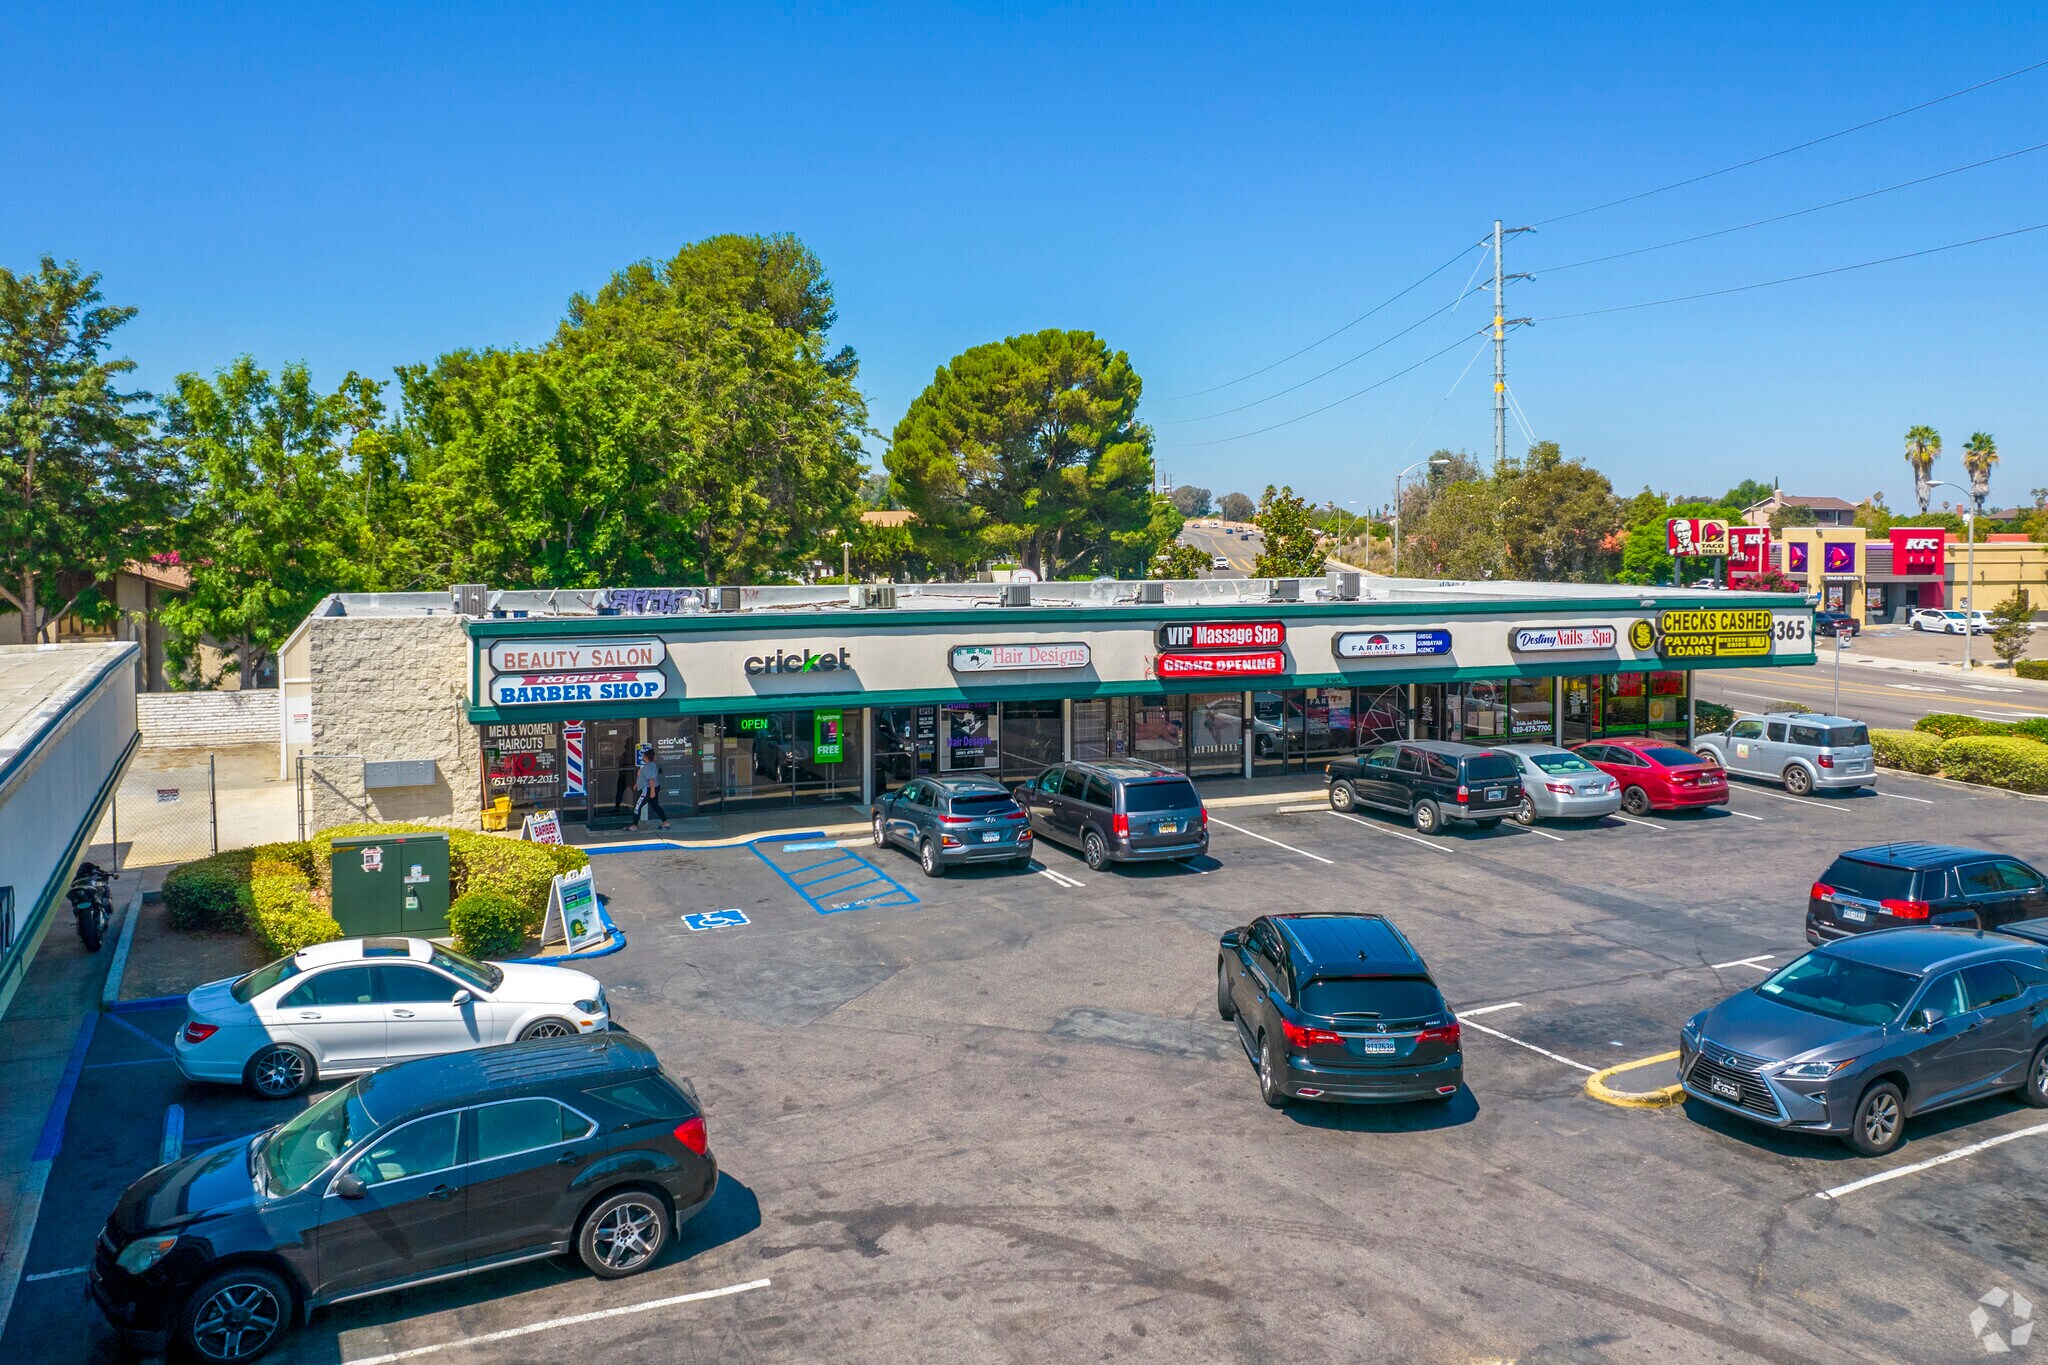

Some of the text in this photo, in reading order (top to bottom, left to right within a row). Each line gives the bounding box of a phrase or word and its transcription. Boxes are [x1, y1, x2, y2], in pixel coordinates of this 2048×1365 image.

[1905, 538, 1939, 550] KFC
[1663, 610, 1771, 631] CHECKS CASHED
[1167, 625, 1279, 645] VIP Massage Spa
[1519, 632, 1557, 648] Destiny
[1557, 629, 1583, 646] Nails
[1592, 628, 1611, 647] Spa
[1664, 635, 1716, 646] PAYDAY
[978, 647, 993, 657] RUN
[1351, 643, 1406, 652] FARMERS
[1668, 646, 1713, 656] LOANS
[504, 648, 652, 670] BEAUTY SALON
[743, 647, 851, 676] cricket
[992, 646, 1085, 667] Hair Designs
[1163, 657, 1276, 672] GRAND OPENING
[536, 672, 624, 685] Roger's
[500, 682, 659, 704] BARBER SHOP
[489, 723, 553, 737] MEN & WOMEN
[740, 718, 768, 730] OPEN
[1512, 724, 1552, 734] 619-475-7700
[498, 737, 544, 751] HAIRCUTS
[657, 736, 687, 745] cricket
[946, 736, 993, 748] Hair Designs
[817, 745, 840, 755] FREE
[534, 822, 558, 838] BARBER
